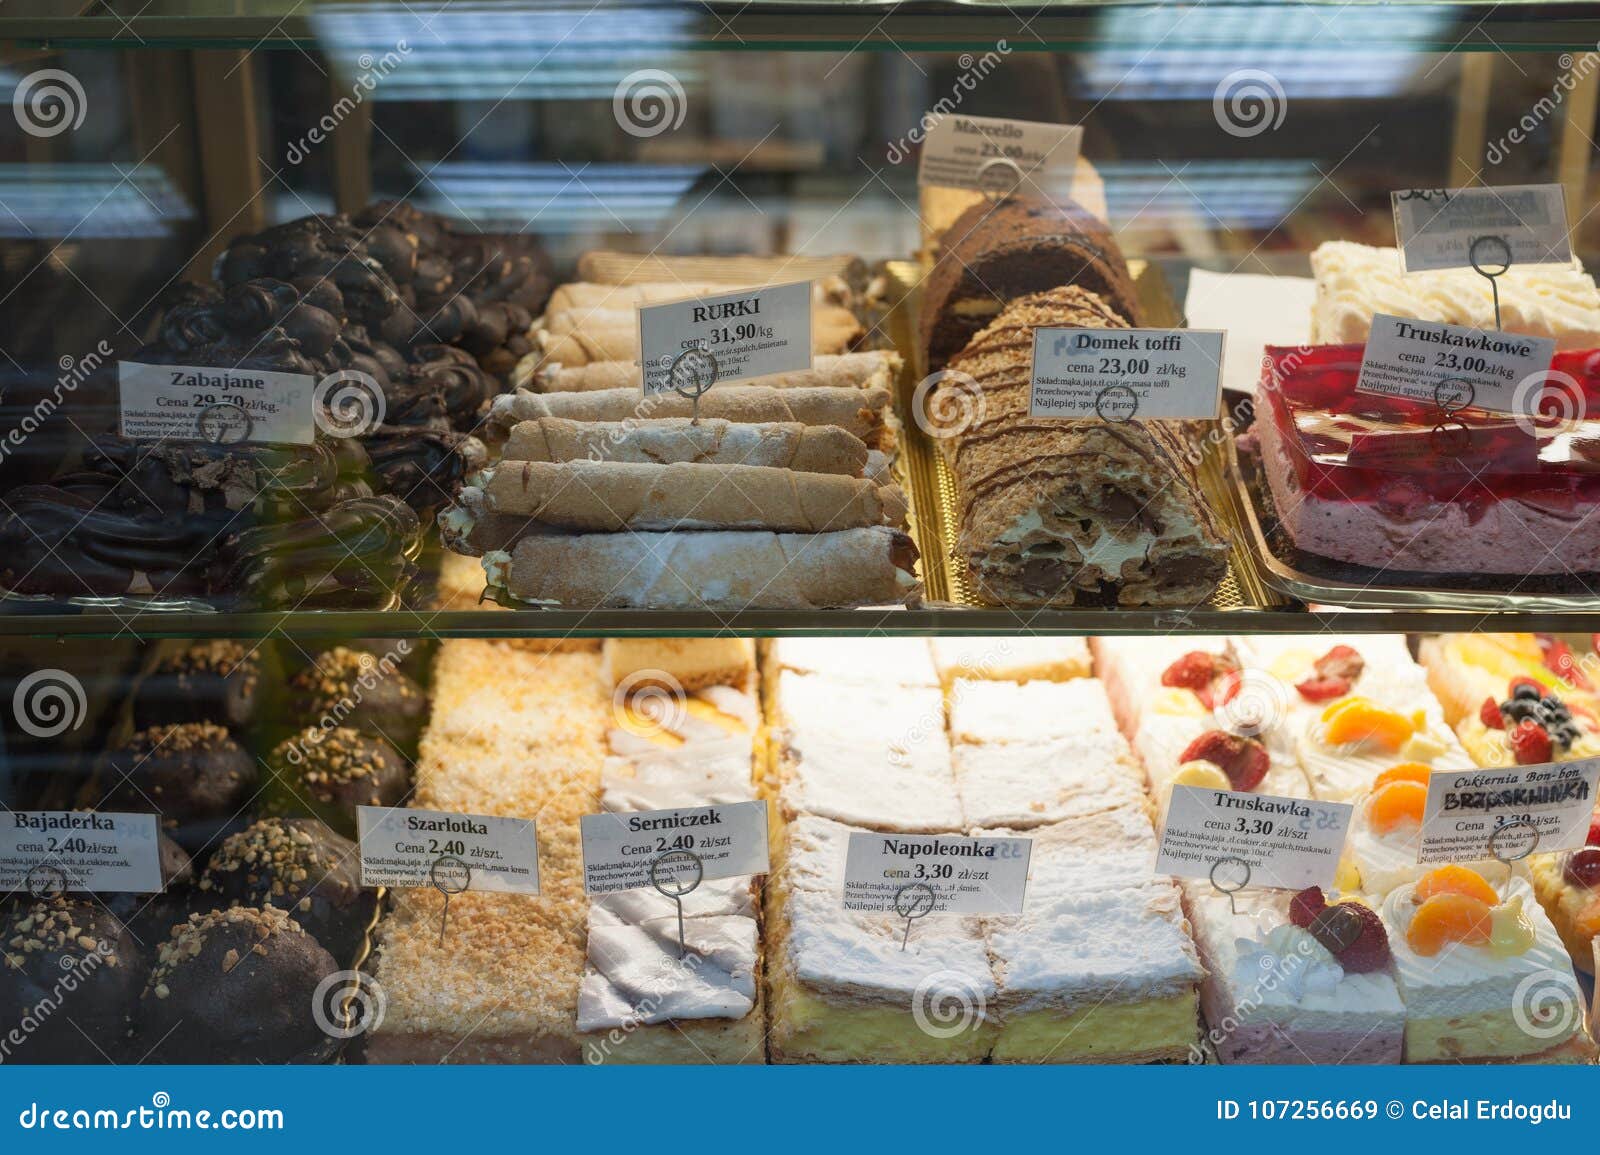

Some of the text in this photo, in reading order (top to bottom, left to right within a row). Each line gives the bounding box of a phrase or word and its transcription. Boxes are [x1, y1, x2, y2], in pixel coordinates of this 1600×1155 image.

[692, 298, 761, 323] RURKI
[710, 323, 773, 345] 31,90/kg
[1076, 333, 1141, 351] Domek
[1145, 334, 1182, 351] toffi
[1396, 321, 1531, 358] Truskawkowe
[1066, 358, 1187, 378] cena 23,00 zł/kg
[1398, 352, 1426, 364] cena
[171, 371, 265, 391] Zabajane
[156, 396, 189, 407] Cena
[1035, 398, 1076, 409] Najlepiej
[1453, 767, 1581, 789] Cukiernia Bon-bon
[1213, 792, 1311, 817] Truskawka
[14, 812, 115, 833] Bajaderka
[628, 809, 722, 833] Serniczek
[1204, 817, 1309, 839] cena 3,30 zł/szt
[1455, 821, 1485, 831] Cena
[16, 843, 44, 853] cena
[395, 838, 504, 860] Cena 2,40 zł/szt.
[621, 844, 653, 856] Cena
[699, 836, 732, 849] zł/szt
[882, 838, 995, 860] Napoleonka
[1162, 848, 1203, 862] Najlepiej
[588, 870, 644, 882] Przechowywać
[883, 863, 990, 881] cena 3,30 zł/szt
[844, 901, 884, 911] Najlepiej
[845, 891, 902, 901] Przechowywa
